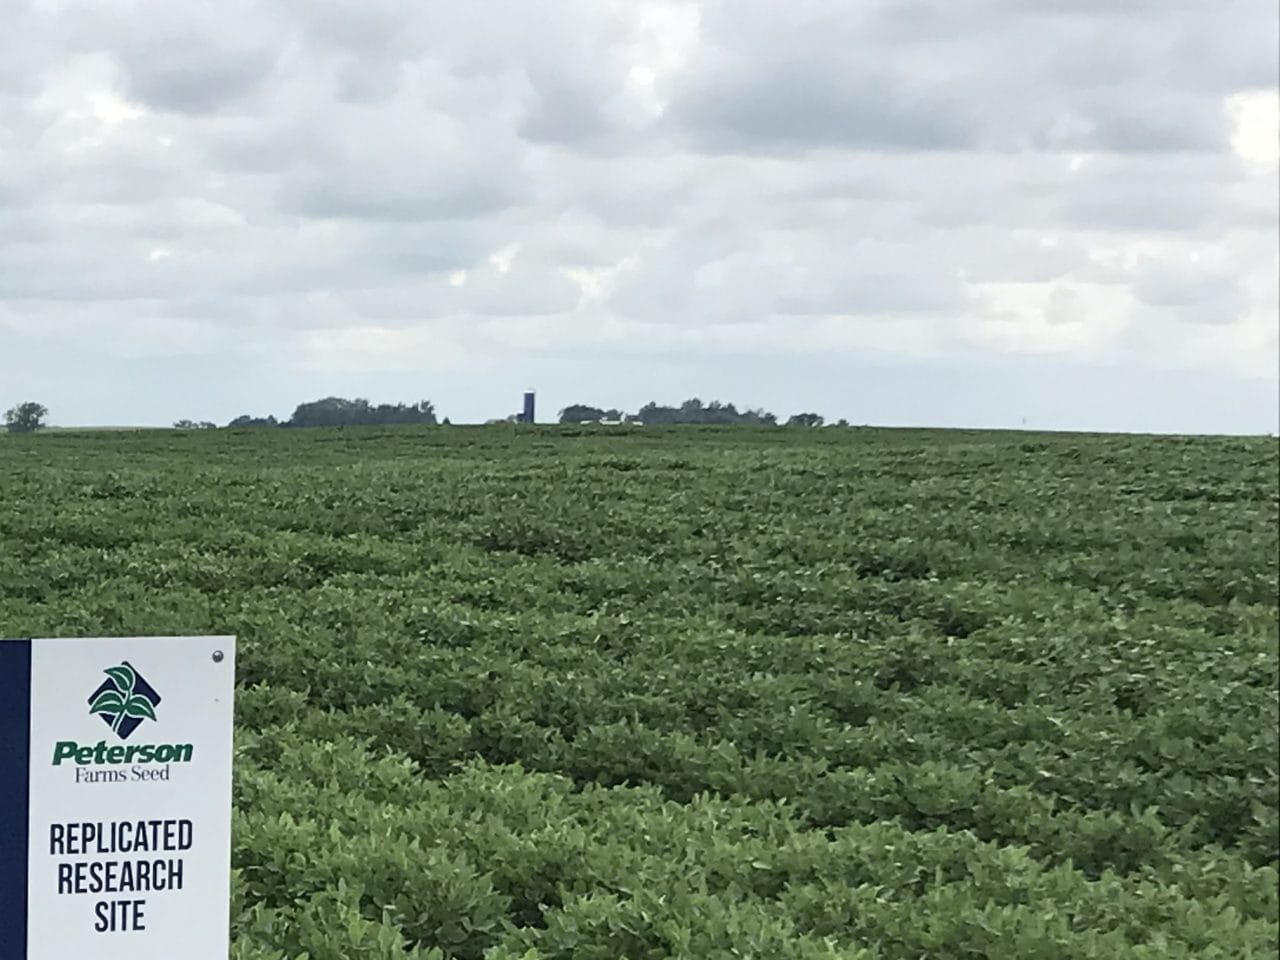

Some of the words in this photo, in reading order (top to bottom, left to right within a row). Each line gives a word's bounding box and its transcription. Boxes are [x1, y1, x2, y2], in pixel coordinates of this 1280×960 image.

[51, 739, 194, 767] Peterson
[74, 766, 128, 784] Farms
[131, 763, 171, 782] Seed
[49, 818, 193, 856] REPLICATED
[57, 858, 184, 895] RESEARCH
[94, 899, 147, 933] SITE
